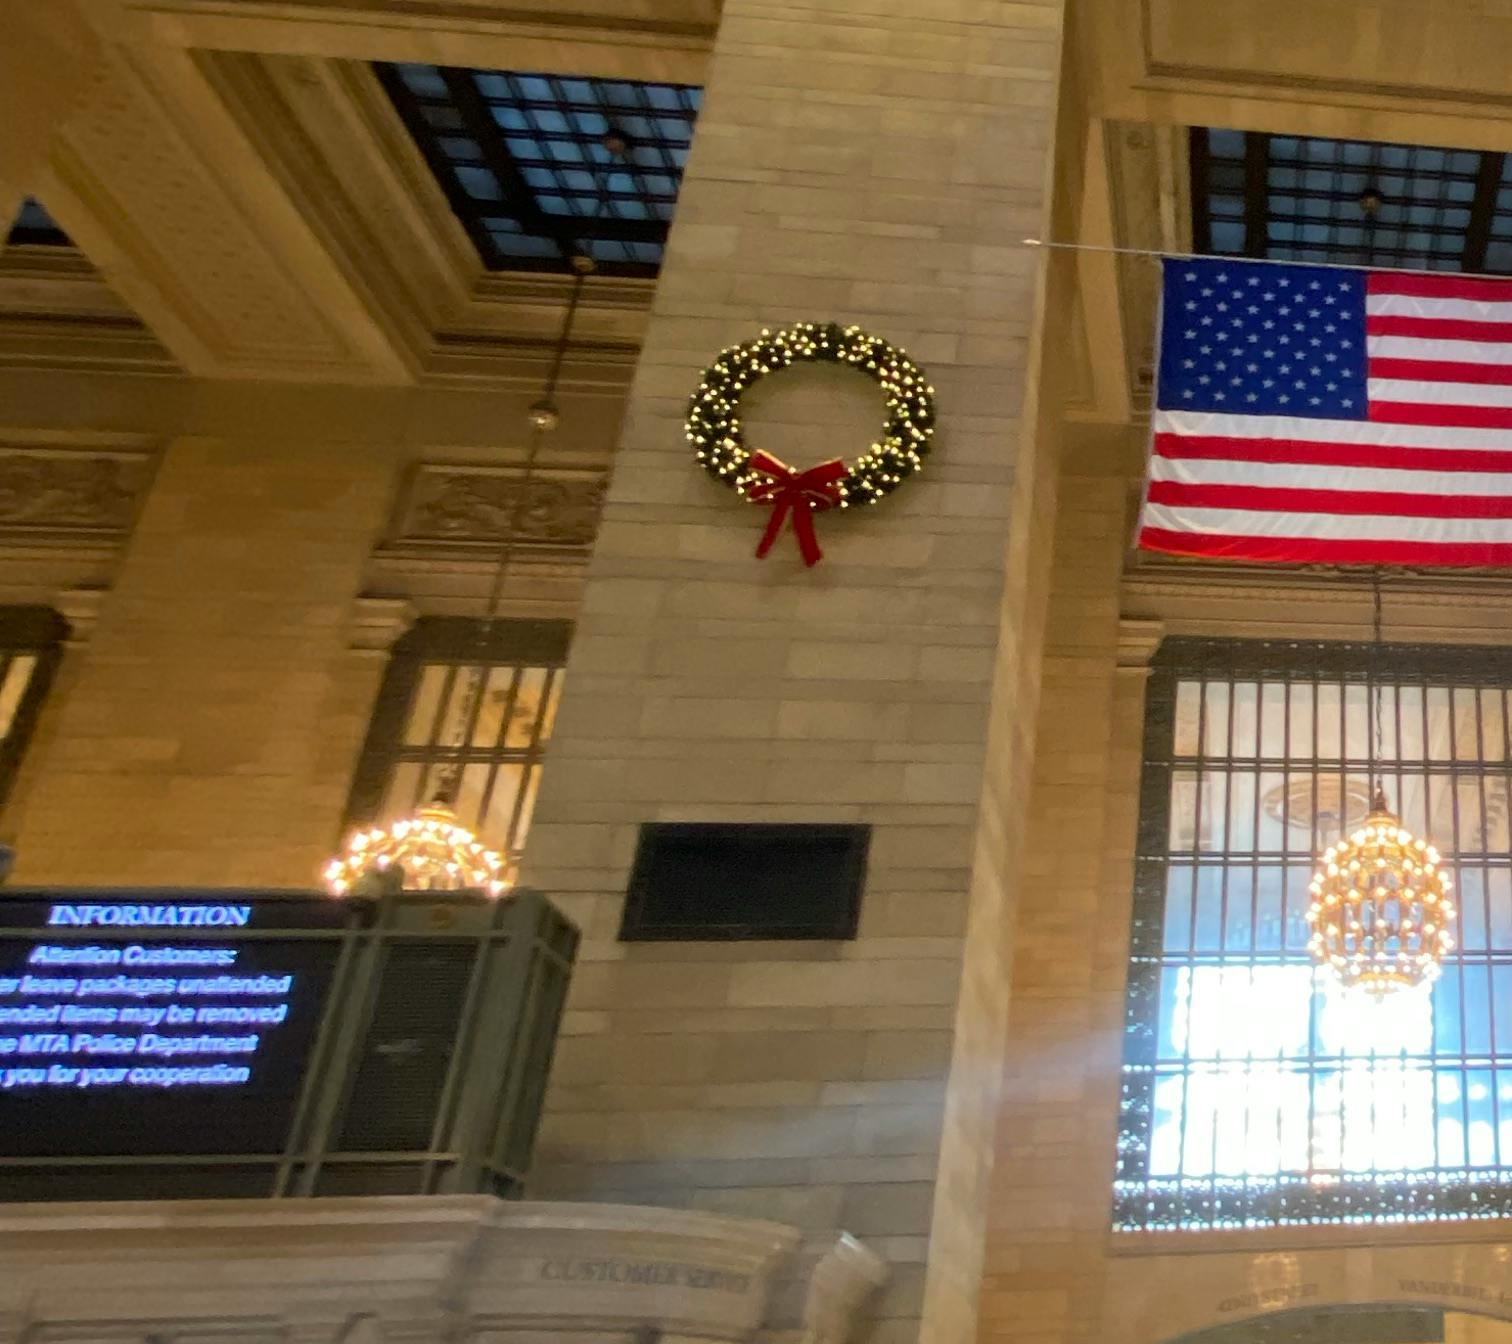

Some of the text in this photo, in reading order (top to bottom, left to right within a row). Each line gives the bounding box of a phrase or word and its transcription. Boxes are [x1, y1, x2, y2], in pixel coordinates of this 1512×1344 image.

[48, 905, 251, 926] INFORMATION
[29, 945, 238, 965] Attention Customers:
[19, 975, 78, 993] leave
[76, 975, 178, 998] packages
[177, 975, 292, 994] unattended
[0, 1004, 288, 1027] ended items may be removed
[18, 1034, 71, 1053] MTA
[71, 1034, 137, 1054] Police
[136, 1033, 260, 1057] Department
[3, 1063, 251, 1087] you for your cooperation
